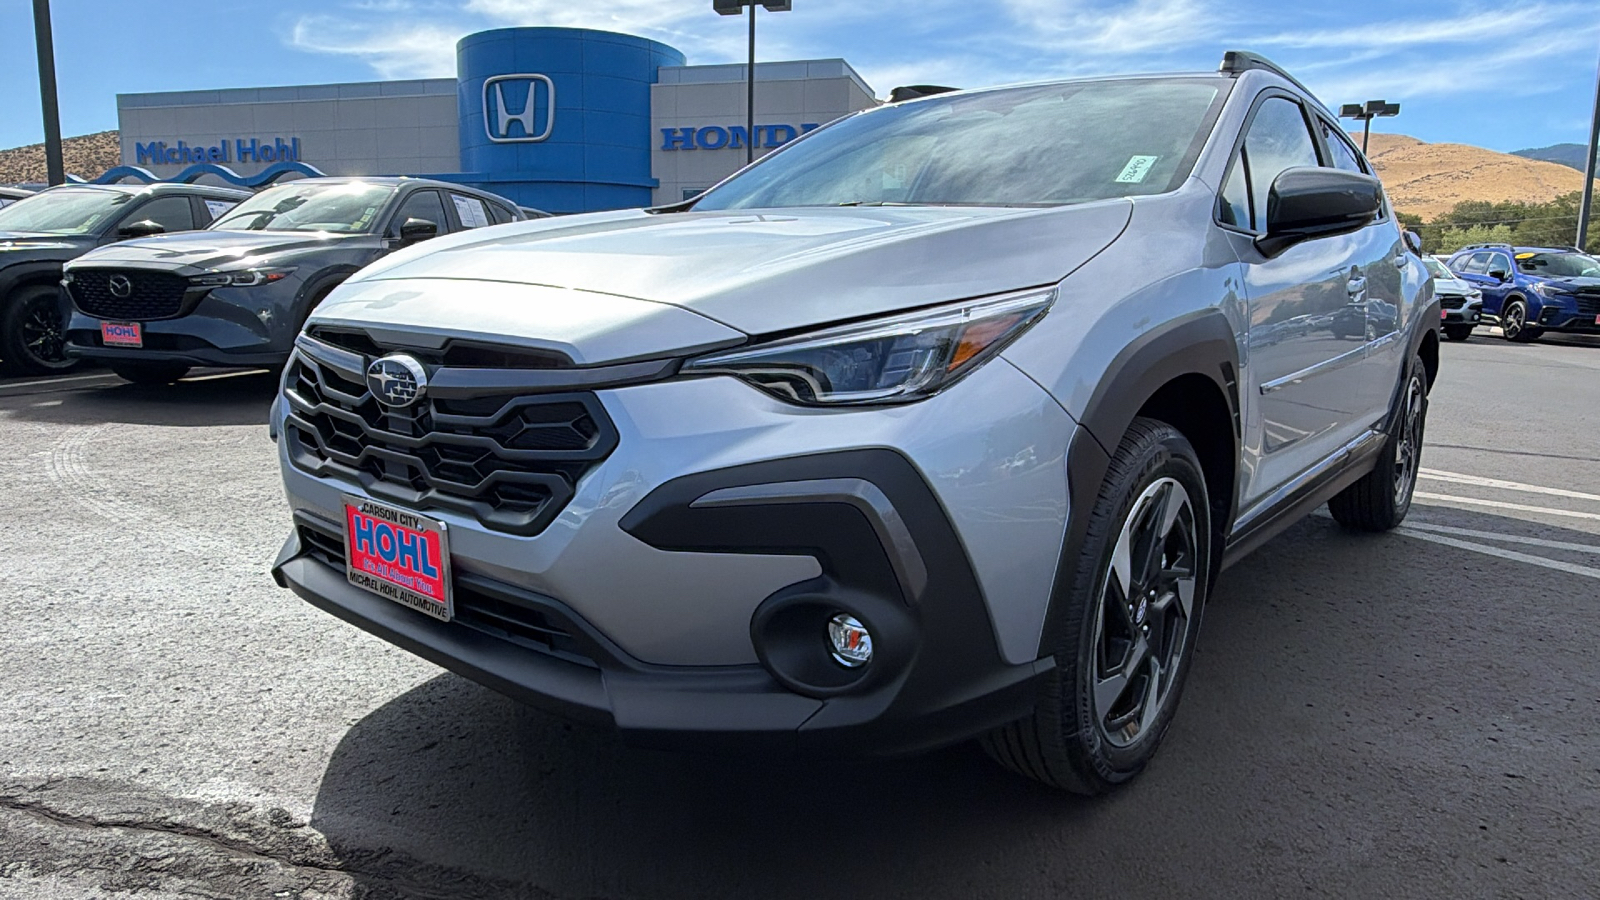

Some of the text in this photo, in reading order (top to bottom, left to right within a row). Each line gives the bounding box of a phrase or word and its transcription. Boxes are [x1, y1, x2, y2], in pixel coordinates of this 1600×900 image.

[135, 137, 300, 165] Michael Hohl
[660, 123, 821, 151] HOND
[106, 325, 137, 337] HOHL
[361, 502, 419, 528] CARSON CITY
[353, 514, 439, 581] HOHL
[363, 558, 376, 572] It's
[376, 563, 388, 576] All
[389, 567, 414, 588] About
[349, 571, 448, 618] MICHAEL HOHL AUTOMOTIVE
